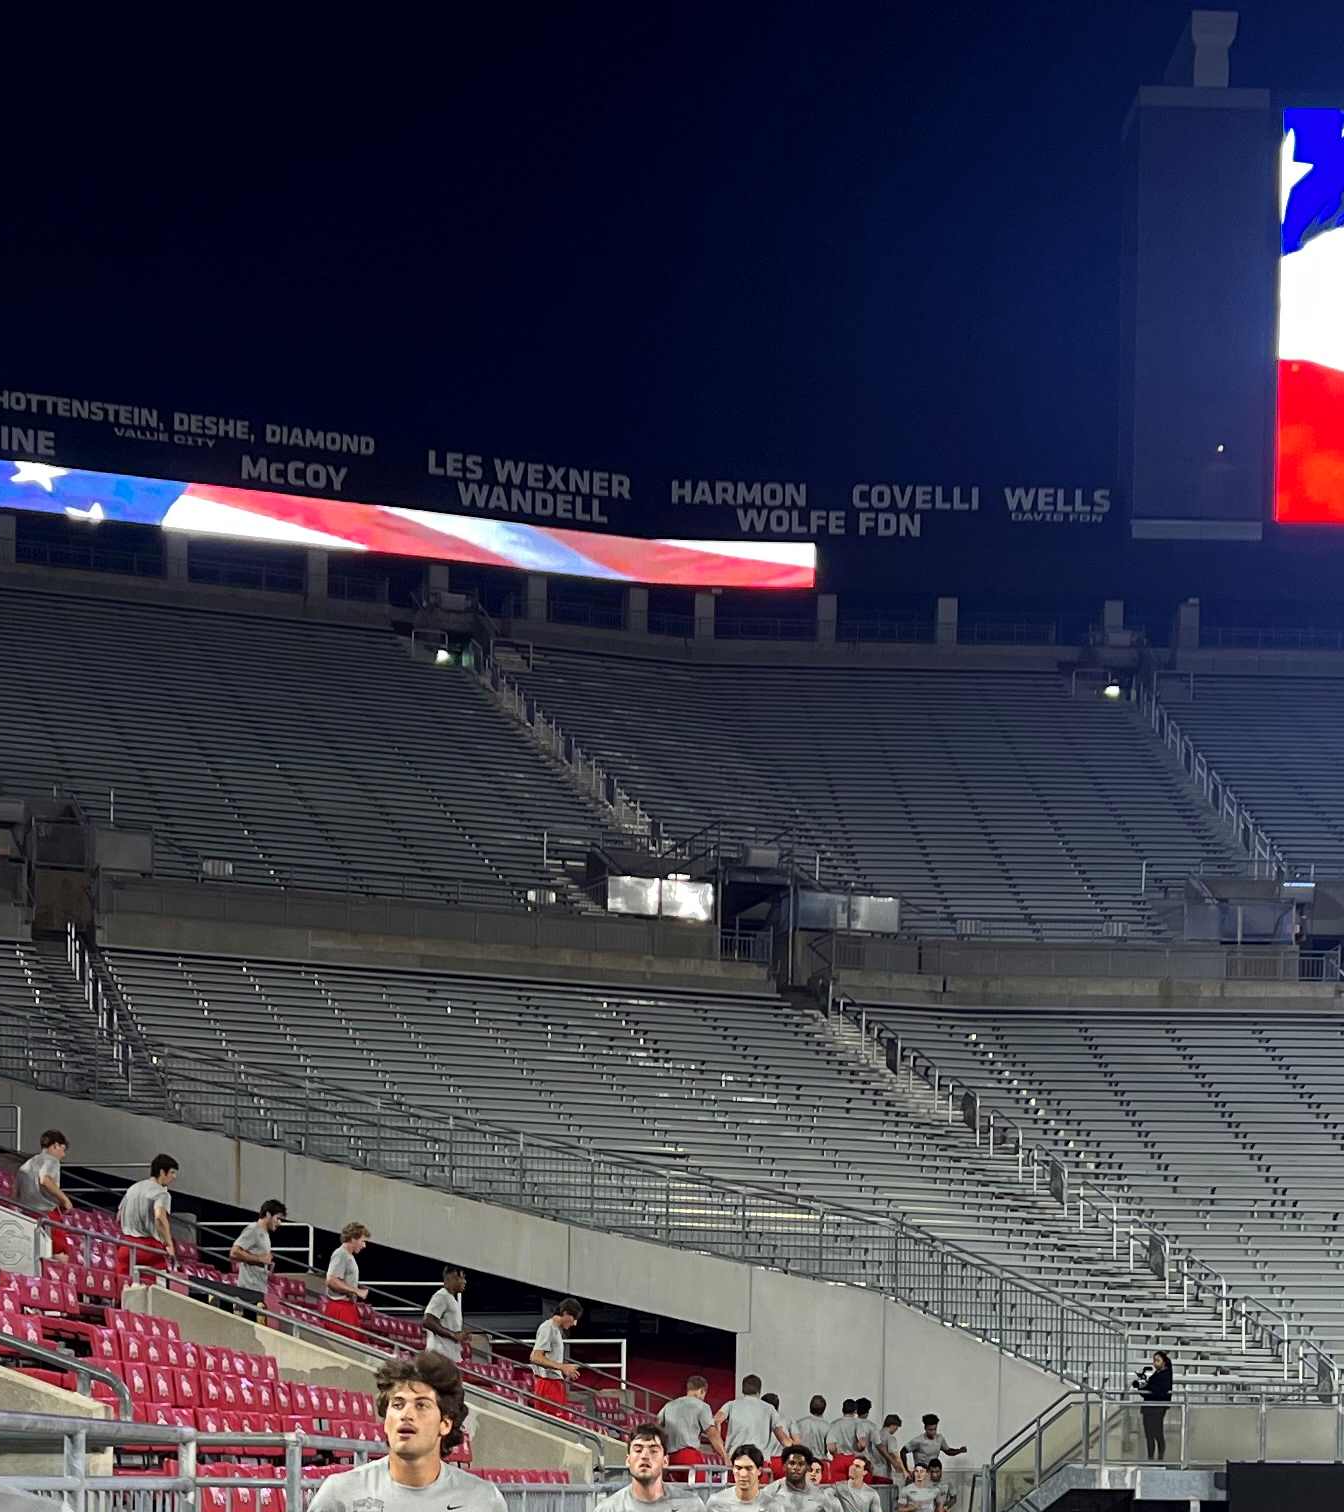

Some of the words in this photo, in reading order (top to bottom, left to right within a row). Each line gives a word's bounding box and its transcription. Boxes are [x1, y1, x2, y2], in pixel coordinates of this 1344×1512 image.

[113, 427, 169, 442] VALUE
[174, 434, 216, 448] CITY
[174, 411, 254, 443] DESHE,
[266, 424, 375, 455] DIAMOND
[241, 455, 348, 491] McCOY
[428, 449, 482, 480] LES
[494, 458, 631, 499] WEXNER
[458, 480, 607, 523] WANDELL
[671, 480, 806, 507] HARMON
[852, 484, 979, 510] COVELLI
[1005, 487, 1111, 513] WELLS
[736, 508, 845, 534] WOLFE
[859, 512, 921, 537] FDN
